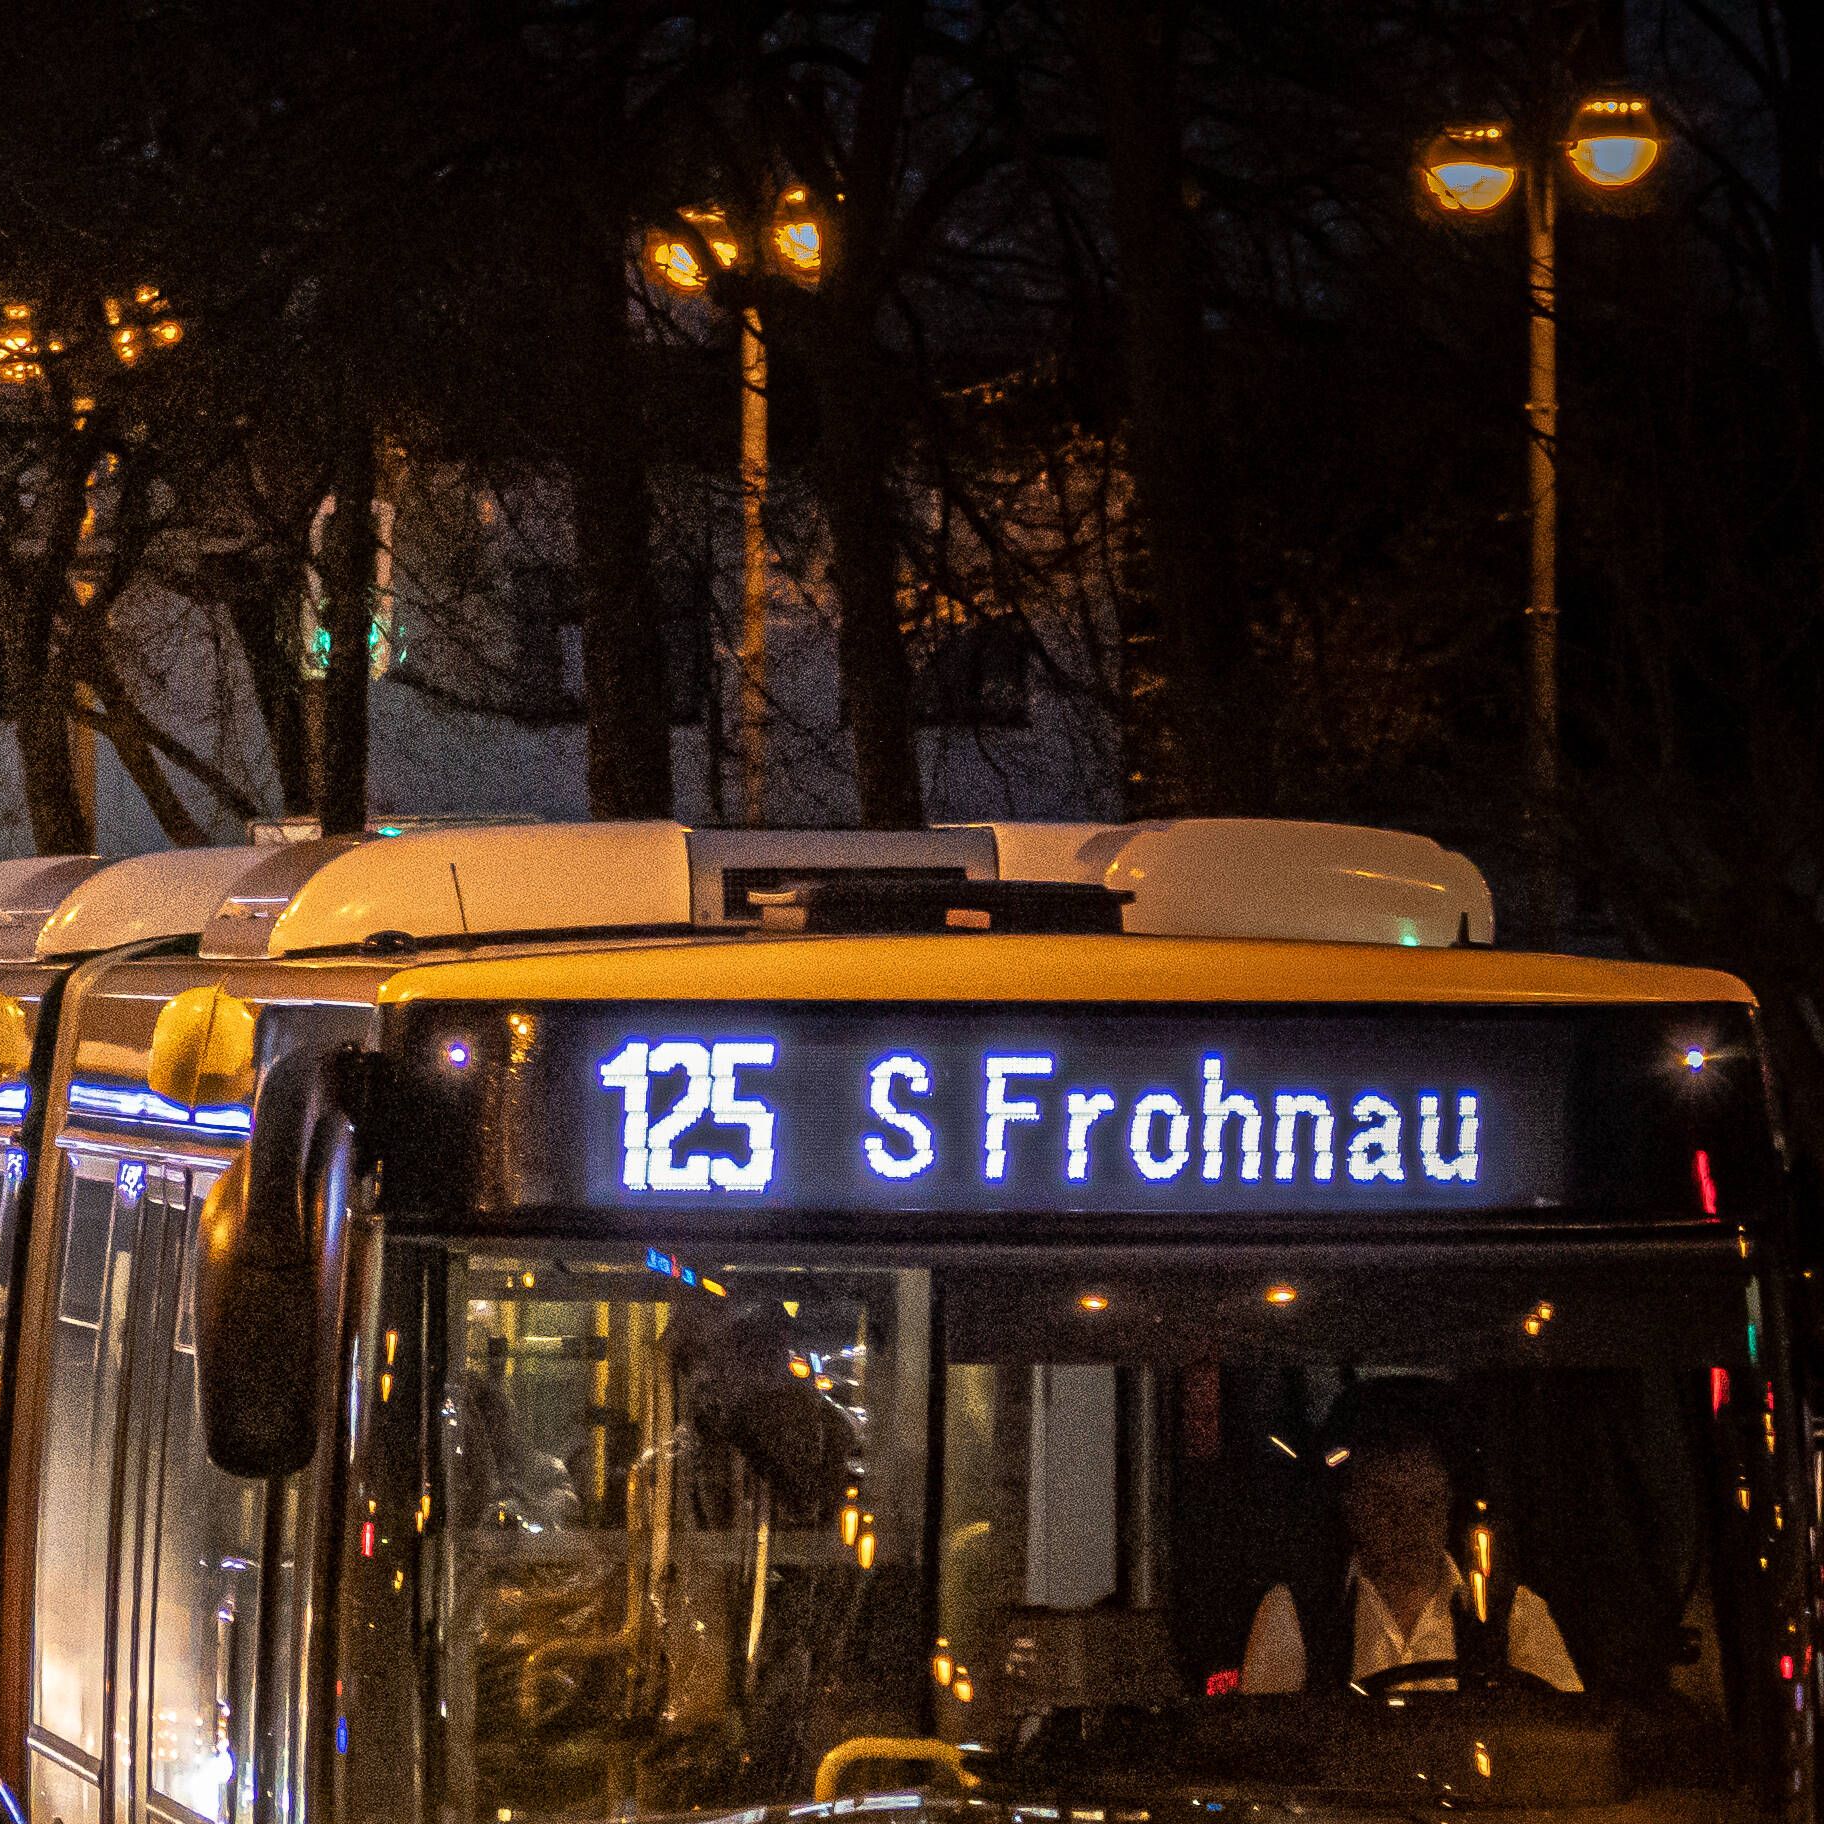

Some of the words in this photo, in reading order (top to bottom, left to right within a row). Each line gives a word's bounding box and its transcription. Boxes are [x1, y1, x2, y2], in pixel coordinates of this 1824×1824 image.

[600, 1040, 778, 1192] 125
[864, 1056, 935, 1181] S
[983, 1056, 1480, 1181] Frohnau
